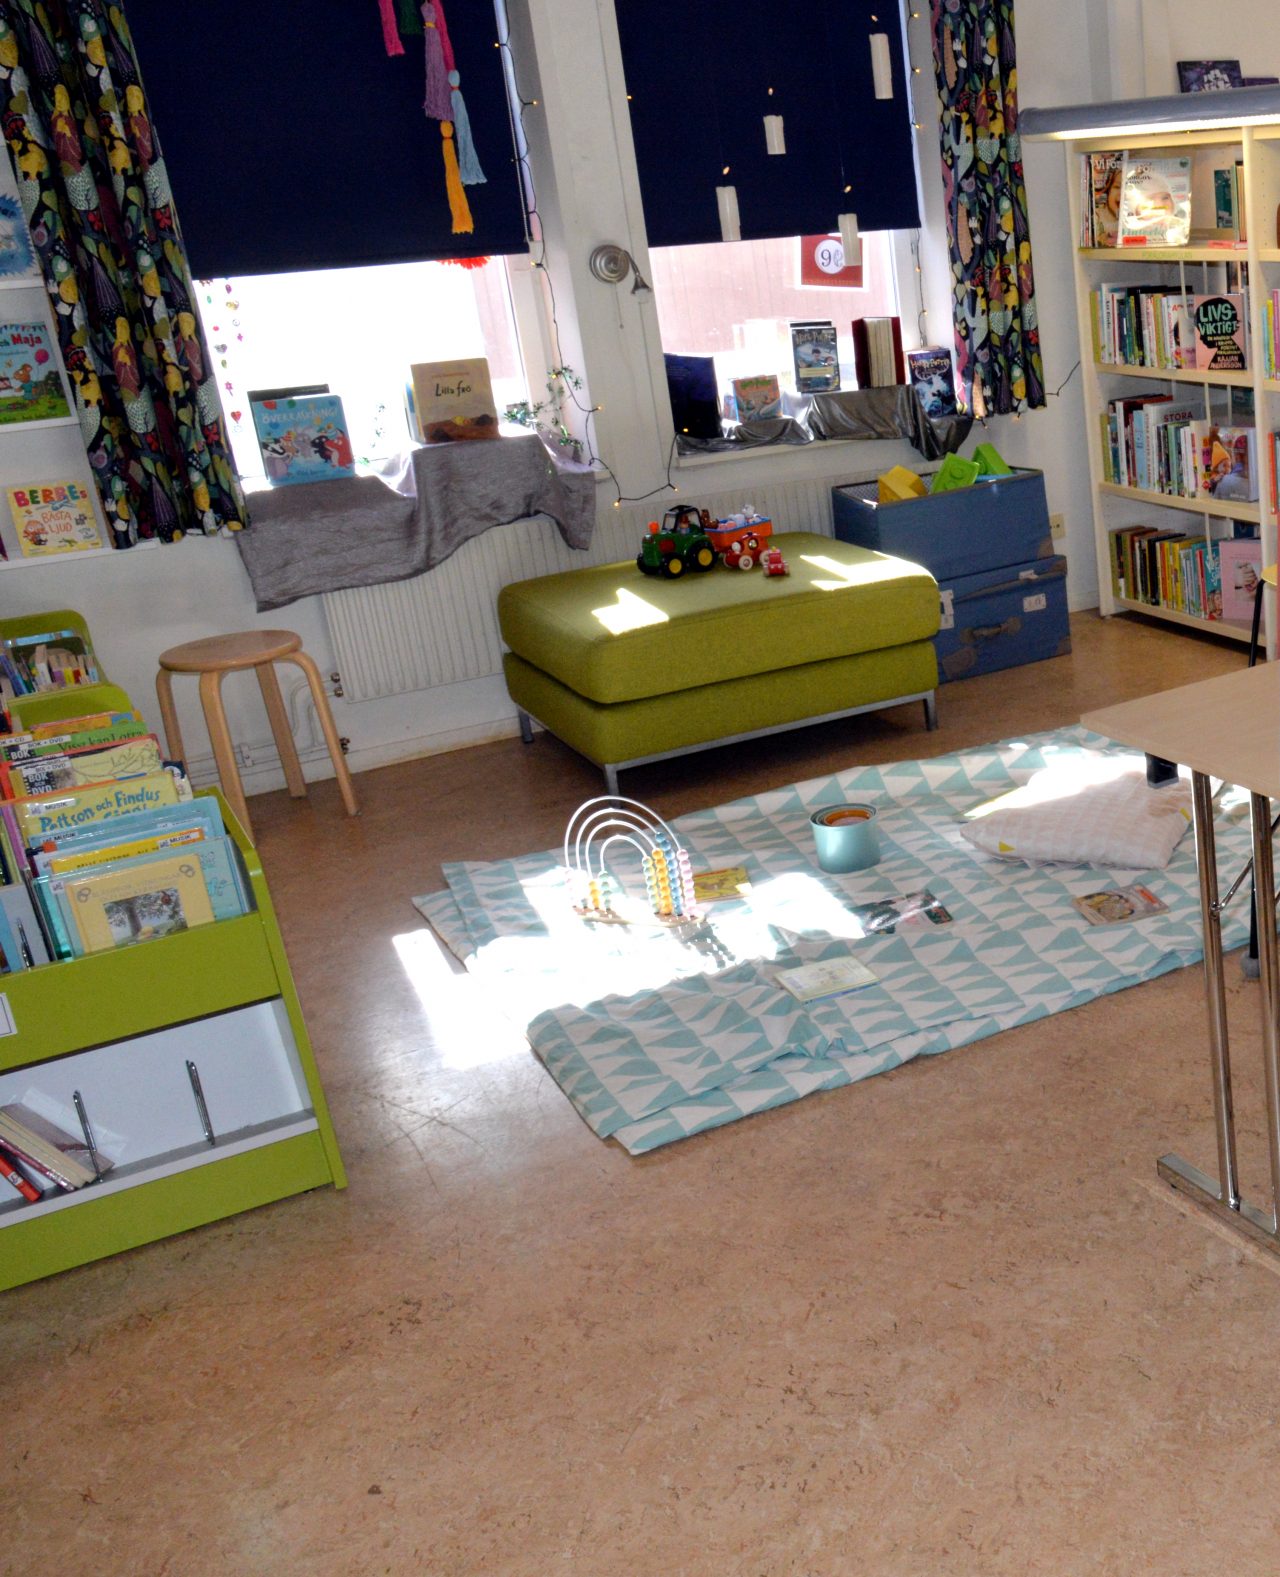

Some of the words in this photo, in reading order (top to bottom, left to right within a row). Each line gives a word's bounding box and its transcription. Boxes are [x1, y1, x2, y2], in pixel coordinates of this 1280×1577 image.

[1200, 303, 1237, 322] LIVS-
[11, 333, 42, 348] Maja
[435, 383, 455, 397] Lilla
[1163, 411, 1193, 422] STORA
[41, 511, 73, 523] BÄSTA
[48, 523, 73, 535] LJUD
[10, 750, 31, 760] BOK
[28, 773, 49, 783] BOK
[32, 785, 52, 796] DVD
[95, 799, 113, 812] och
[114, 786, 160, 806] Findus
